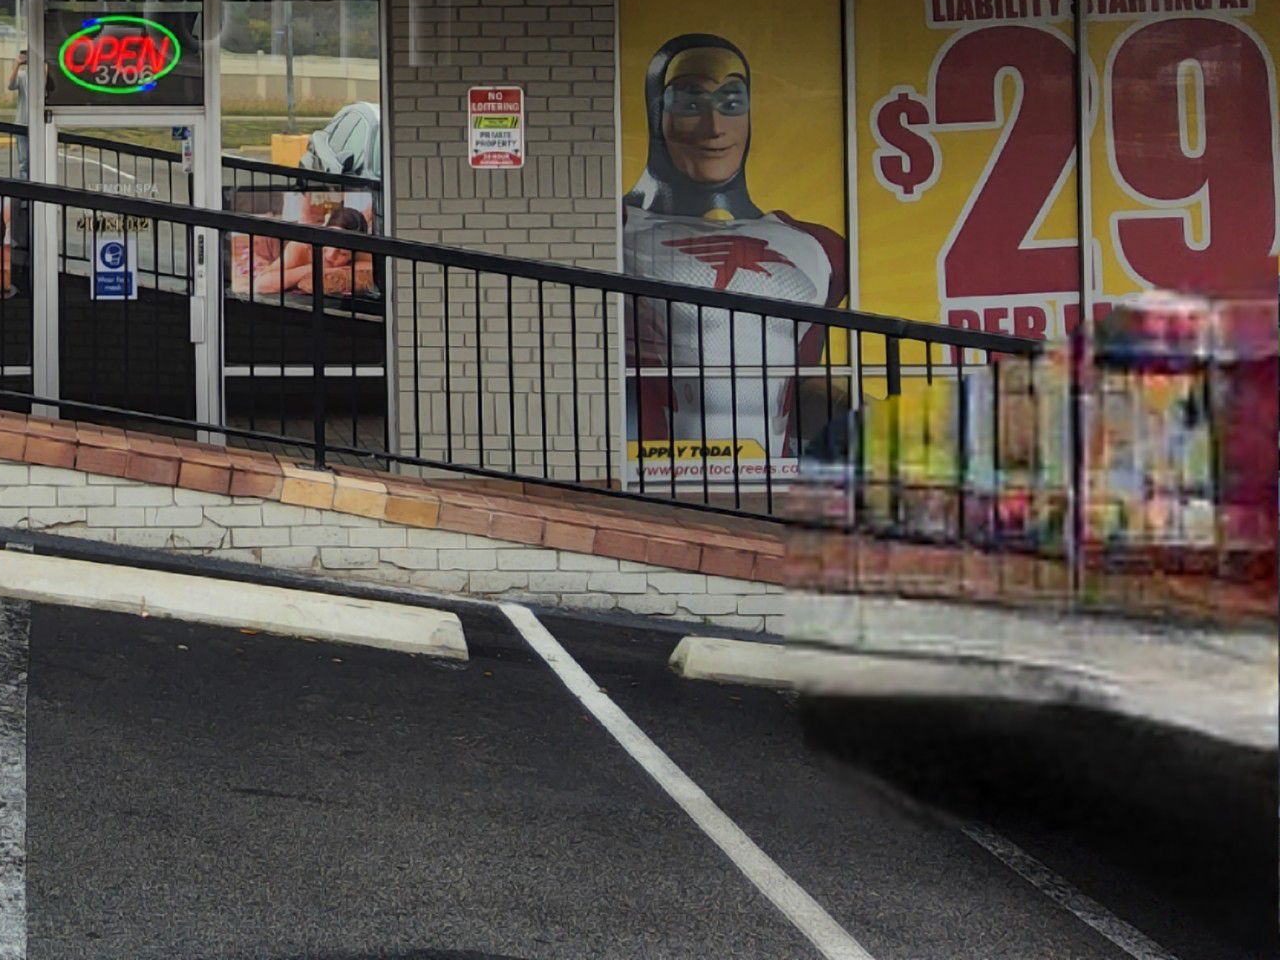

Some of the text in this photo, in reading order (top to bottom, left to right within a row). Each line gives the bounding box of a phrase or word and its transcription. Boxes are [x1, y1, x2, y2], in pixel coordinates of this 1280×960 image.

[64, 34, 170, 74] OPEN
[95, 65, 154, 85] 3706
[488, 92, 503, 101] NO
[472, 103, 519, 111] LOITERING
[88, 183, 160, 194] LEMON SPA
[636, 446, 687, 458] APPY
